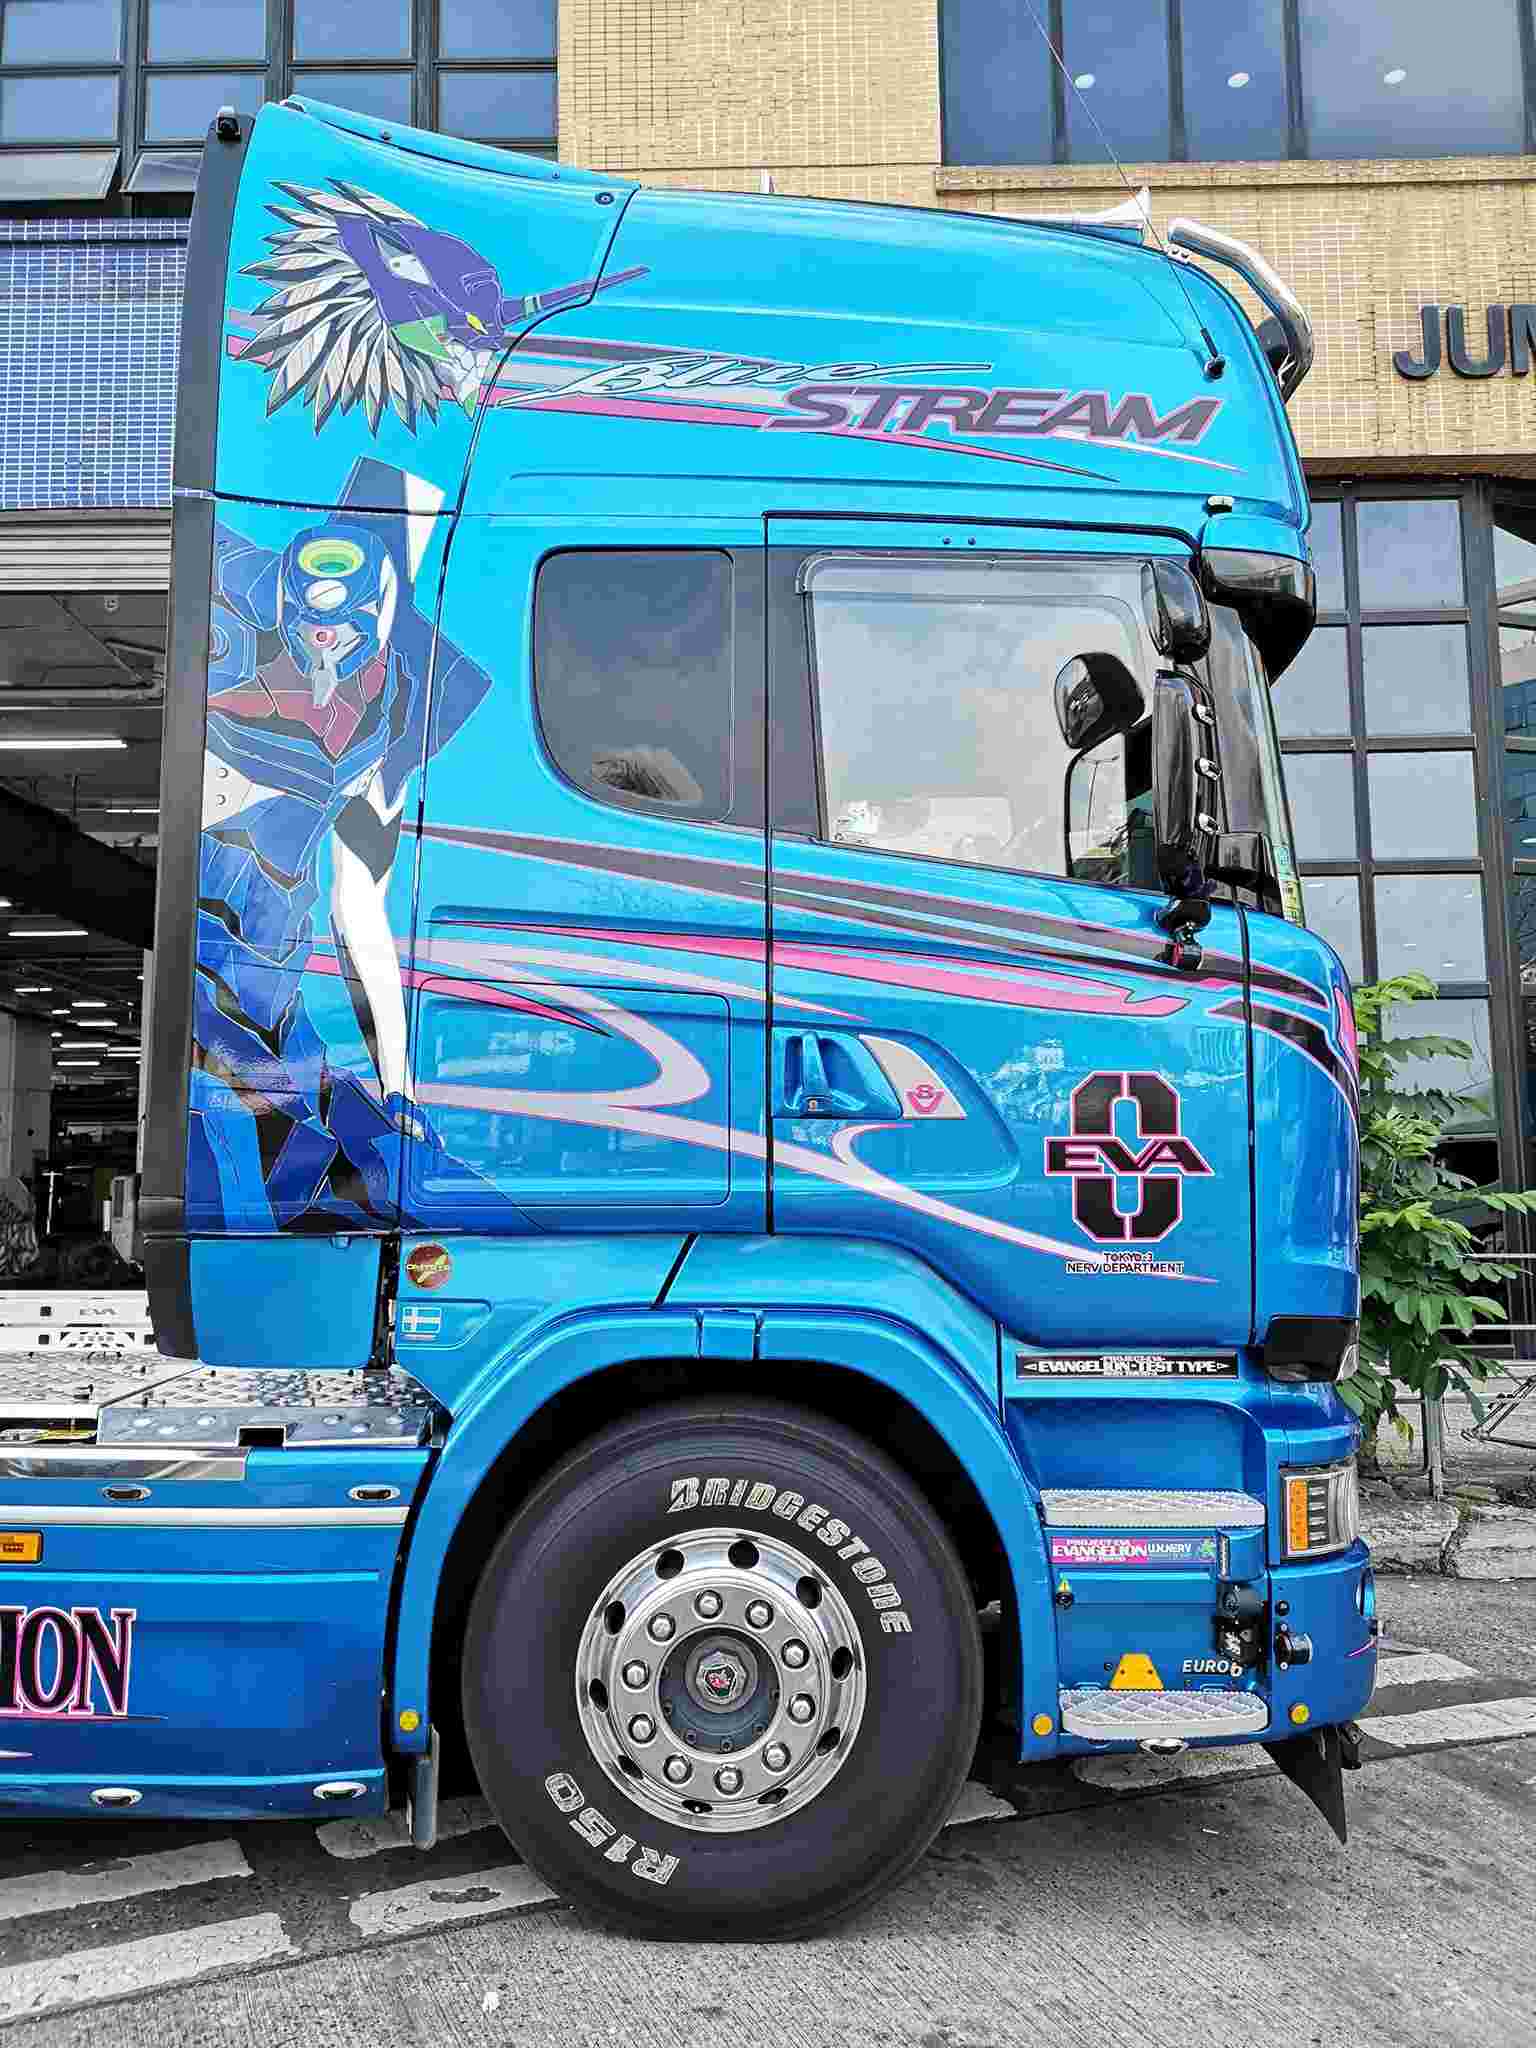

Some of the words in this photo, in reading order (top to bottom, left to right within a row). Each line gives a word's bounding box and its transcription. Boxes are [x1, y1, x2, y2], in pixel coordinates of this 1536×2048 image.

[764, 383, 1223, 446] STREAM
[1044, 1136, 1216, 1176] EVA
[1066, 1263, 1099, 1273] NERV
[1103, 1263, 1183, 1273] DEPARTMENT
[666, 1477, 913, 1633] BRIDGESTONE
[1052, 1544, 1148, 1557] EVANGELION
[545, 1773, 680, 1885] R150
